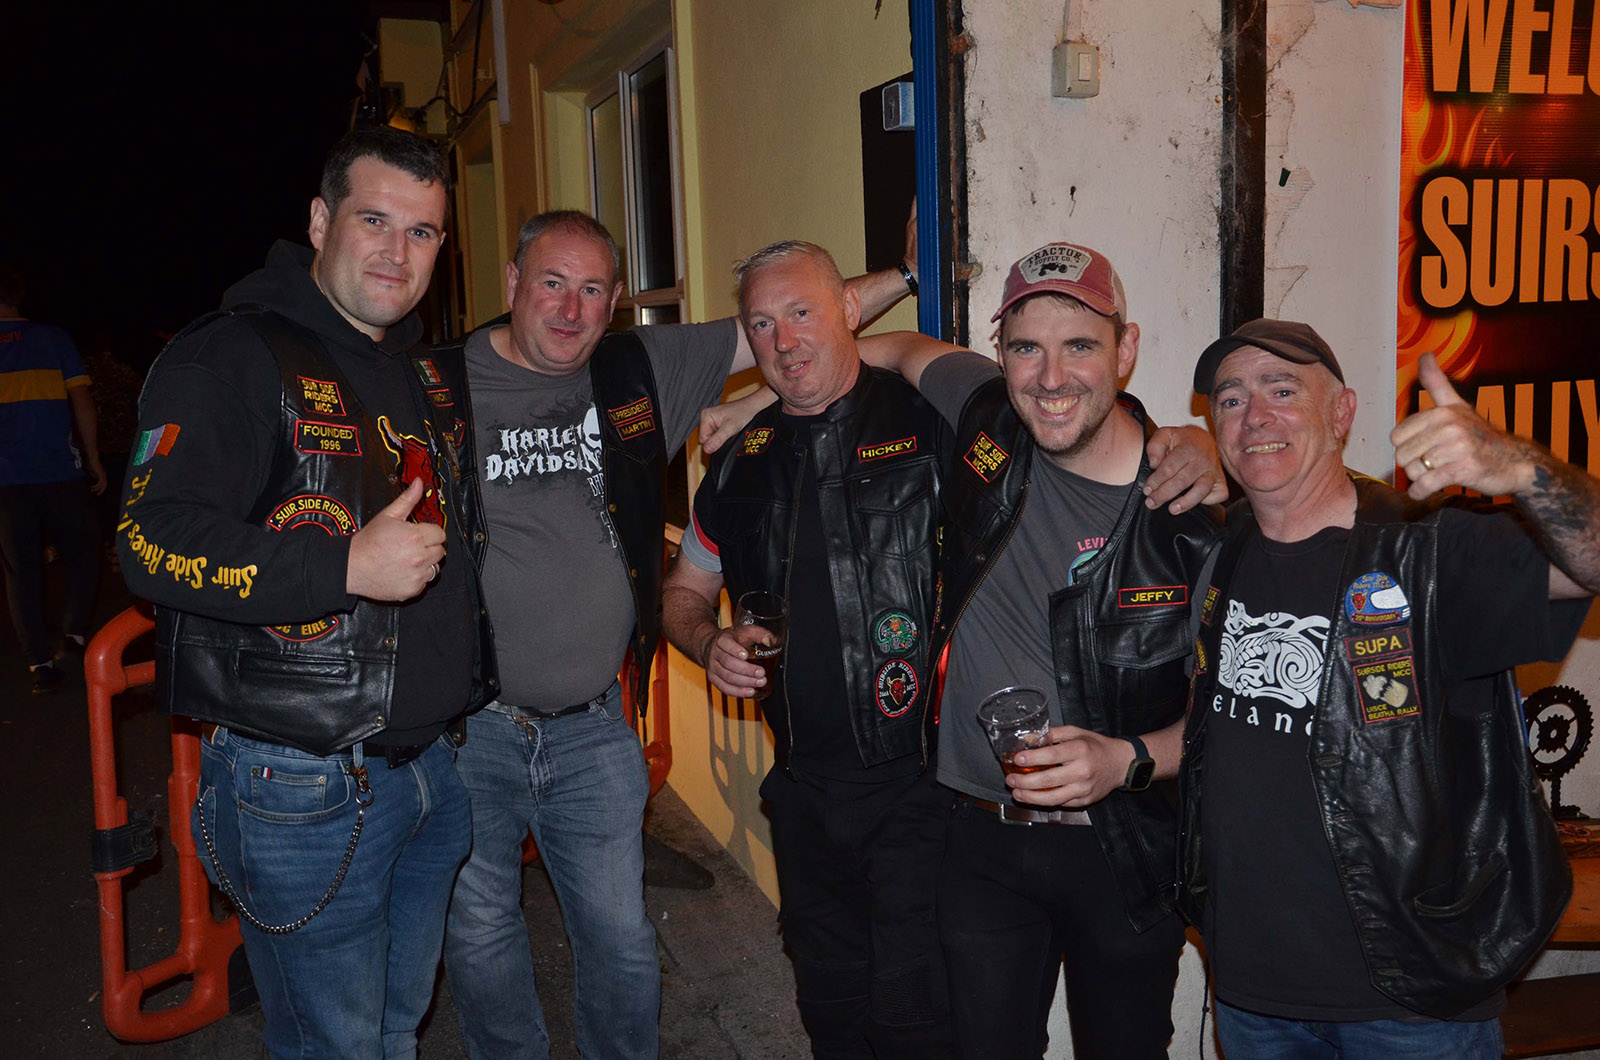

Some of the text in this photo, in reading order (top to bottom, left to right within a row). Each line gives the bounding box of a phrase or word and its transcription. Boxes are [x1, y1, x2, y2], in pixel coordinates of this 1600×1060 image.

[1430, 0, 1600, 95] WEL
[1420, 176, 1600, 309] SUIR
[1026, 247, 1082, 265] TRACTOR
[1034, 255, 1060, 266] SUPPLY
[304, 390, 339, 404] RIDERS
[315, 401, 334, 413] MCC
[303, 425, 353, 440] FOUNDED
[621, 419, 652, 436] MARTIN
[320, 439, 341, 451] 1996
[862, 440, 913, 458] HICKEY
[973, 444, 999, 471] RIDERS
[275, 498, 352, 531] SUIR SIDE RIDERS
[165, 553, 208, 589] Side
[211, 564, 258, 599] Suir
[1130, 590, 1175, 603] JEFFY
[300, 619, 328, 636] EIRE
[1354, 635, 1403, 656] SUPA
[1356, 660, 1411, 676] SUIRSIDE RIDERS
[1393, 668, 1411, 678] MCC
[1366, 704, 1388, 713] UISCE
[1368, 705, 1418, 720] BEATHA RALLY
